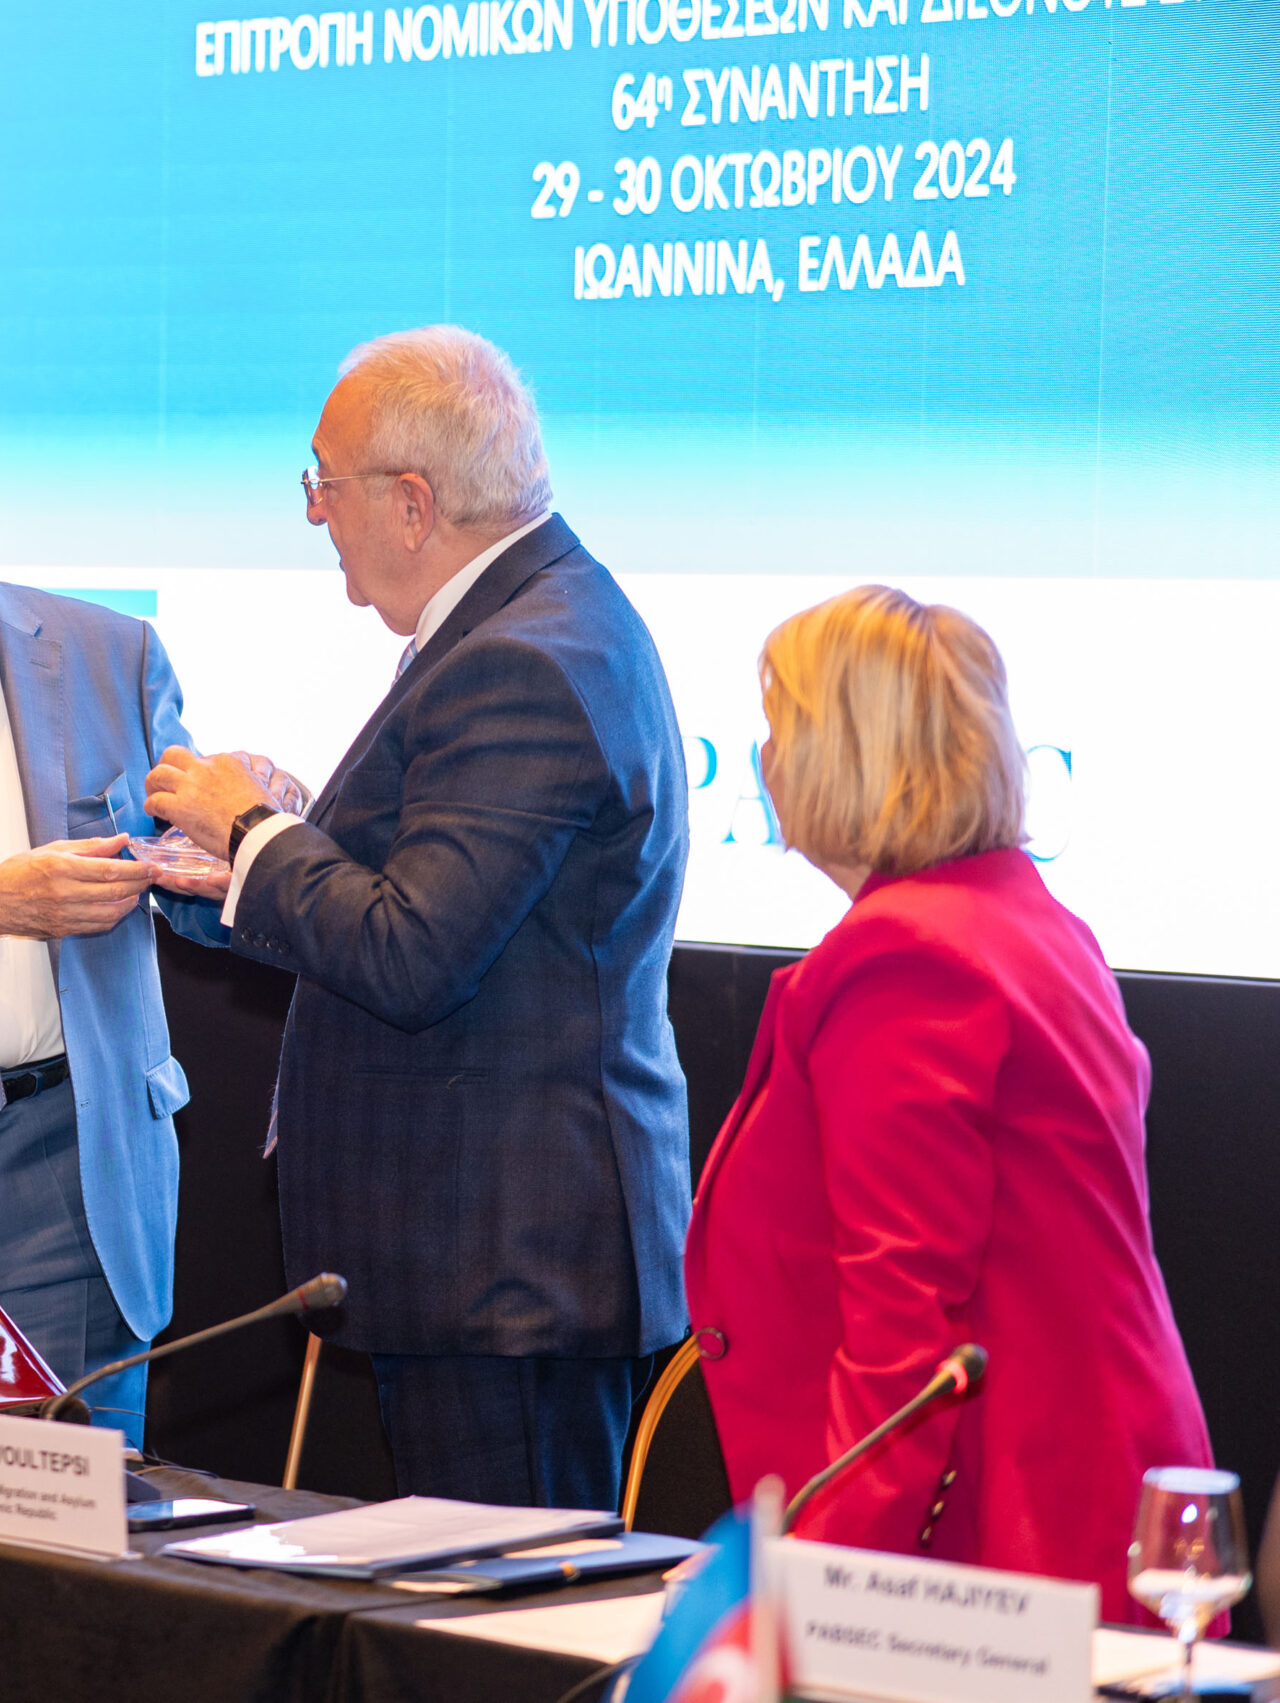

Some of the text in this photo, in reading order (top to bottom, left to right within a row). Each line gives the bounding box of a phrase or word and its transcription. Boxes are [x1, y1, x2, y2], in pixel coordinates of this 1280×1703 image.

[195, 12, 372, 76] ΕΠΙΤΡΟΠΗ
[383, 1, 573, 63] ΝΟΜΙΚΩΝ
[681, 54, 930, 126] ΣΥΝΑΝΤΗΣΗ
[530, 138, 1016, 219] 29 - 30 ΟΚΤΩΒΡΙΟΥ 2024
[573, 230, 966, 303] ΙΩΑΝΝΙΝΑ, ΕΛΛΑΔΑ
[40, 1491, 57, 1502] and
[825, 1566, 857, 1590] Mr.
